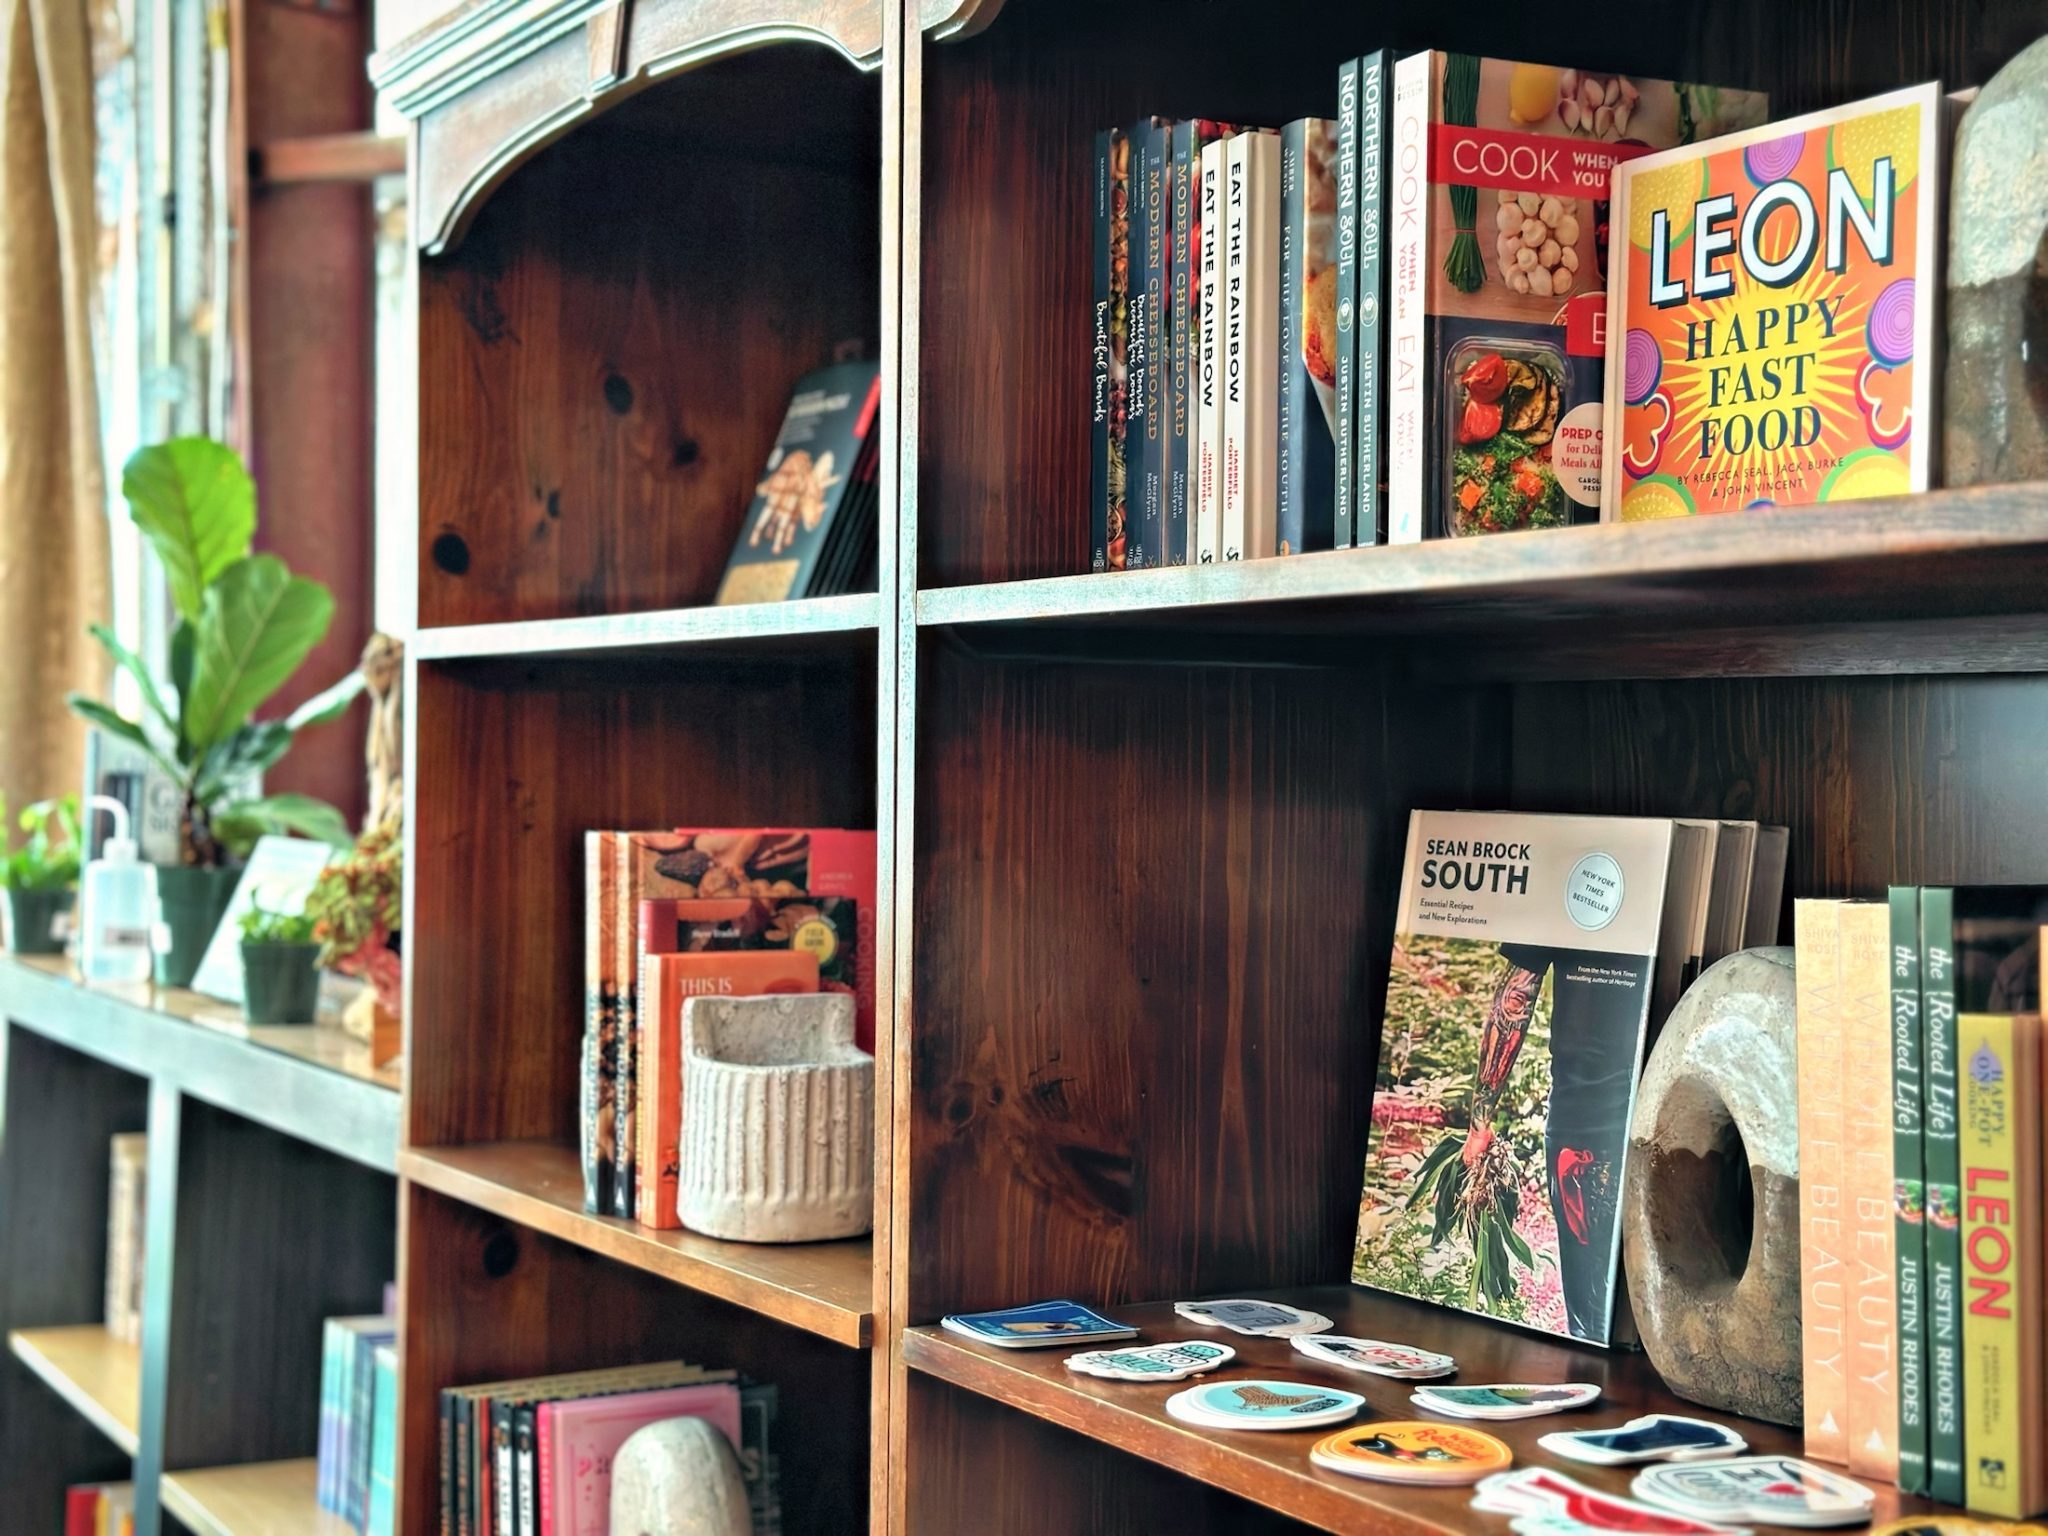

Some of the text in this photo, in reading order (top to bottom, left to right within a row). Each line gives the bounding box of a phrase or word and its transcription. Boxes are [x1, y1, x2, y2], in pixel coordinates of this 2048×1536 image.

[1340, 73, 1355, 276] NORTHERN SOUL
[1364, 64, 1379, 269] NORTHERN SOUL
[1400, 116, 1418, 231] COOK
[1453, 139, 1560, 183] COOK
[1573, 152, 1618, 169] WHEN
[1573, 171, 1605, 188] YOU
[1649, 156, 1896, 310] LEON
[1204, 169, 1214, 406] EAT THE RAINBOW
[1230, 162, 1241, 402] EAT THE RAINBOW
[1408, 242, 1416, 291] WHEN
[1149, 170, 1159, 440] MODERN CHEESEBOARD
[1176, 164, 1186, 436] MODERN CHEESEBOARD
[1282, 314, 1290, 364] LOVE
[1685, 295, 1845, 362] HAPPY
[1282, 372, 1289, 396] OF
[1398, 335, 1414, 393] EAT
[1708, 352, 1816, 409] FAST
[1340, 355, 1348, 516] JUSTIN SUTHERLAND
[1363, 351, 1372, 513] JUSTIN SUTHERLAND
[1561, 427, 1592, 440] PREP
[1566, 444, 1580, 454] for
[1698, 405, 1822, 460] FOOD
[1560, 458, 1587, 468] Meals
[1677, 475, 1689, 486] BY
[1694, 469, 1740, 484] REBECCA
[1776, 462, 1803, 477] JACK
[1808, 457, 1844, 470] BURKE
[1722, 482, 1750, 499] JOHN
[1755, 478, 1804, 492] VINCENT
[1426, 839, 1531, 861] SEAN BROCK
[1420, 859, 1530, 896] SOUTH
[1581, 869, 1616, 888] NEW YORK
[1586, 884, 1605, 897] TIMES
[1418, 912, 1488, 926] and New Explorations
[1420, 898, 1474, 912] Essential Recipes
[1572, 892, 1609, 914] BESTSELLER
[1566, 974, 1592, 984] bestselling
[1592, 976, 1608, 984] author
[1614, 978, 1636, 988] Heritage
[1578, 965, 1637, 978] From the New York Times
[1896, 944, 1918, 978] the
[1928, 946, 1953, 980] the
[680, 977, 732, 996] THIS IS
[1977, 1056, 1992, 1147] ONE-POT
[1992, 1070, 2004, 1136] HAPPY
[1966, 1167, 2011, 1320] LEON
[1810, 1184, 1842, 1378] BEAUTY
[1857, 1197, 1889, 1394] BEAUTY
[1902, 1256, 1919, 1426] JUSTIN RHODES
[1936, 1262, 1954, 1436] JUSTIN RHODES
